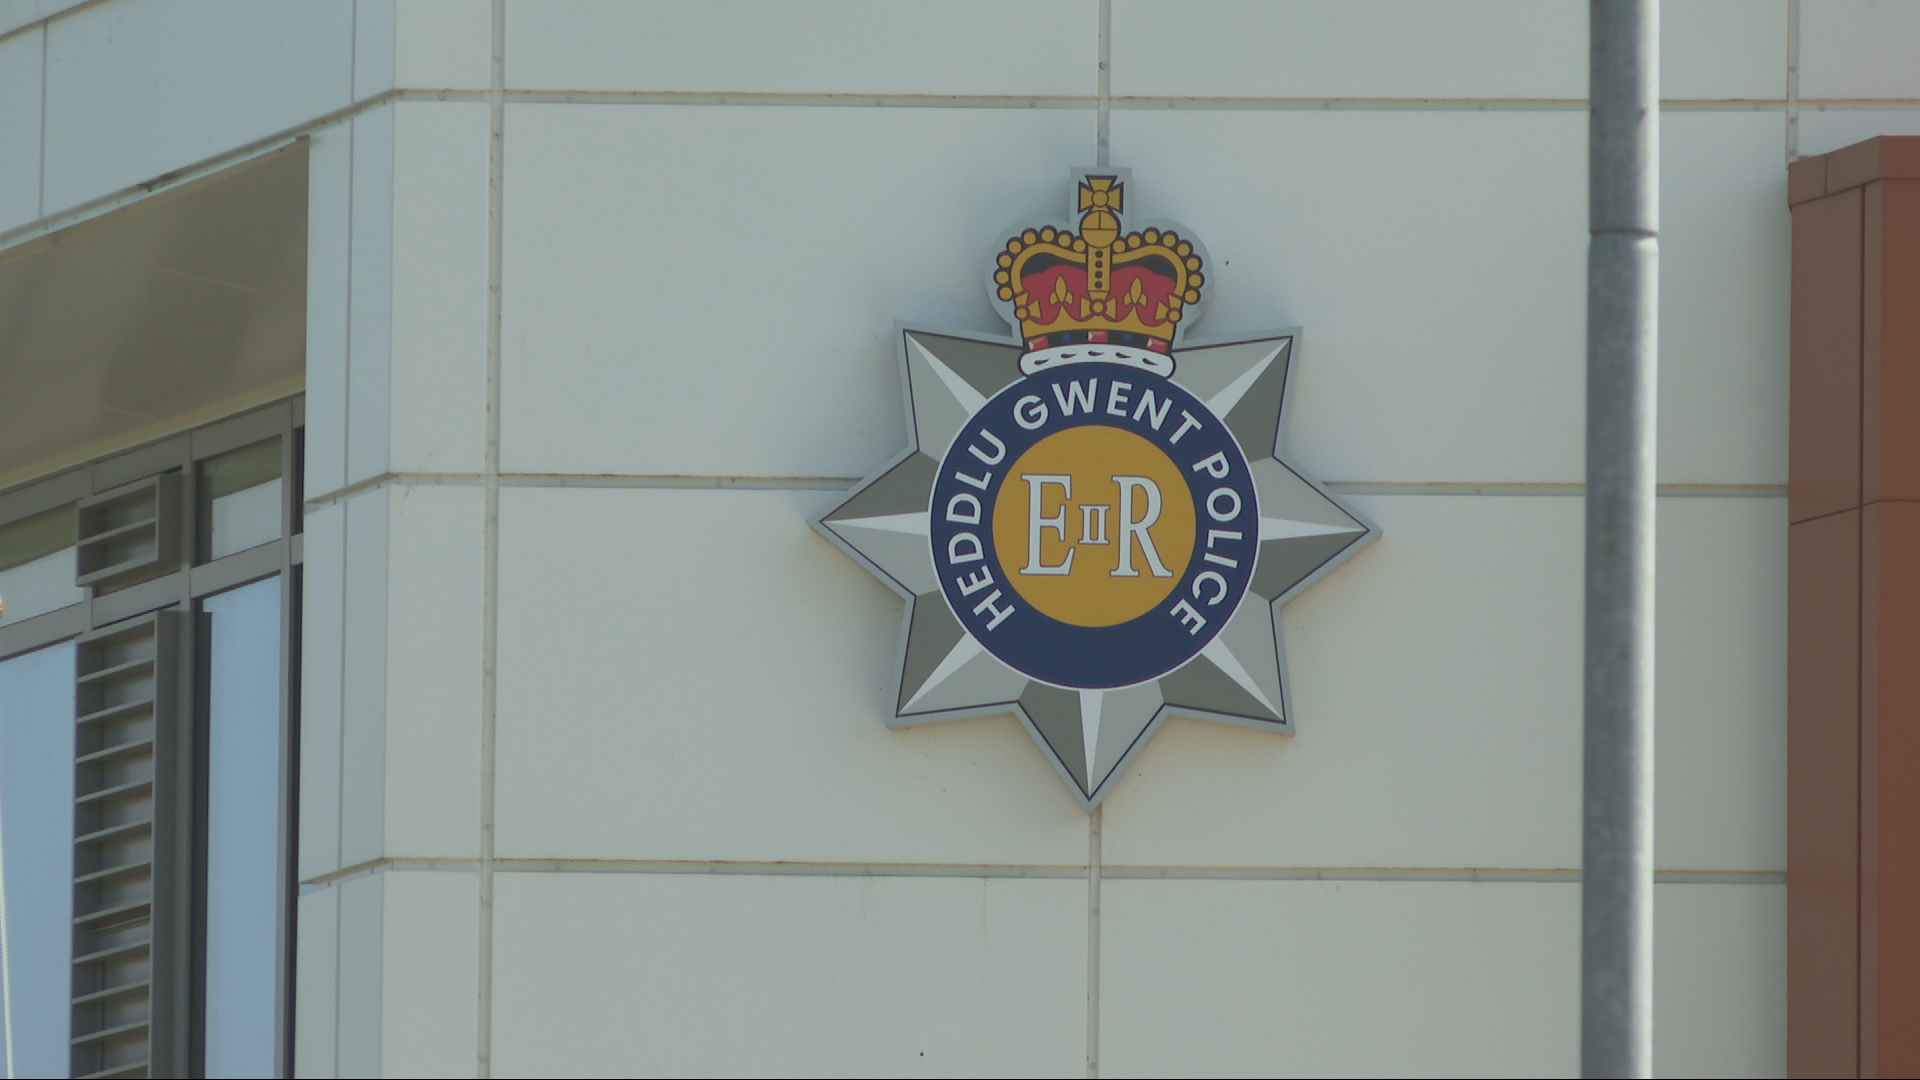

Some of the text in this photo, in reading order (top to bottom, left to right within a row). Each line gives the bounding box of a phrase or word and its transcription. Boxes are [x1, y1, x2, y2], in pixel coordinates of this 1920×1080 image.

[946, 377, 1243, 636] HEDDLU GWENT POLICE
